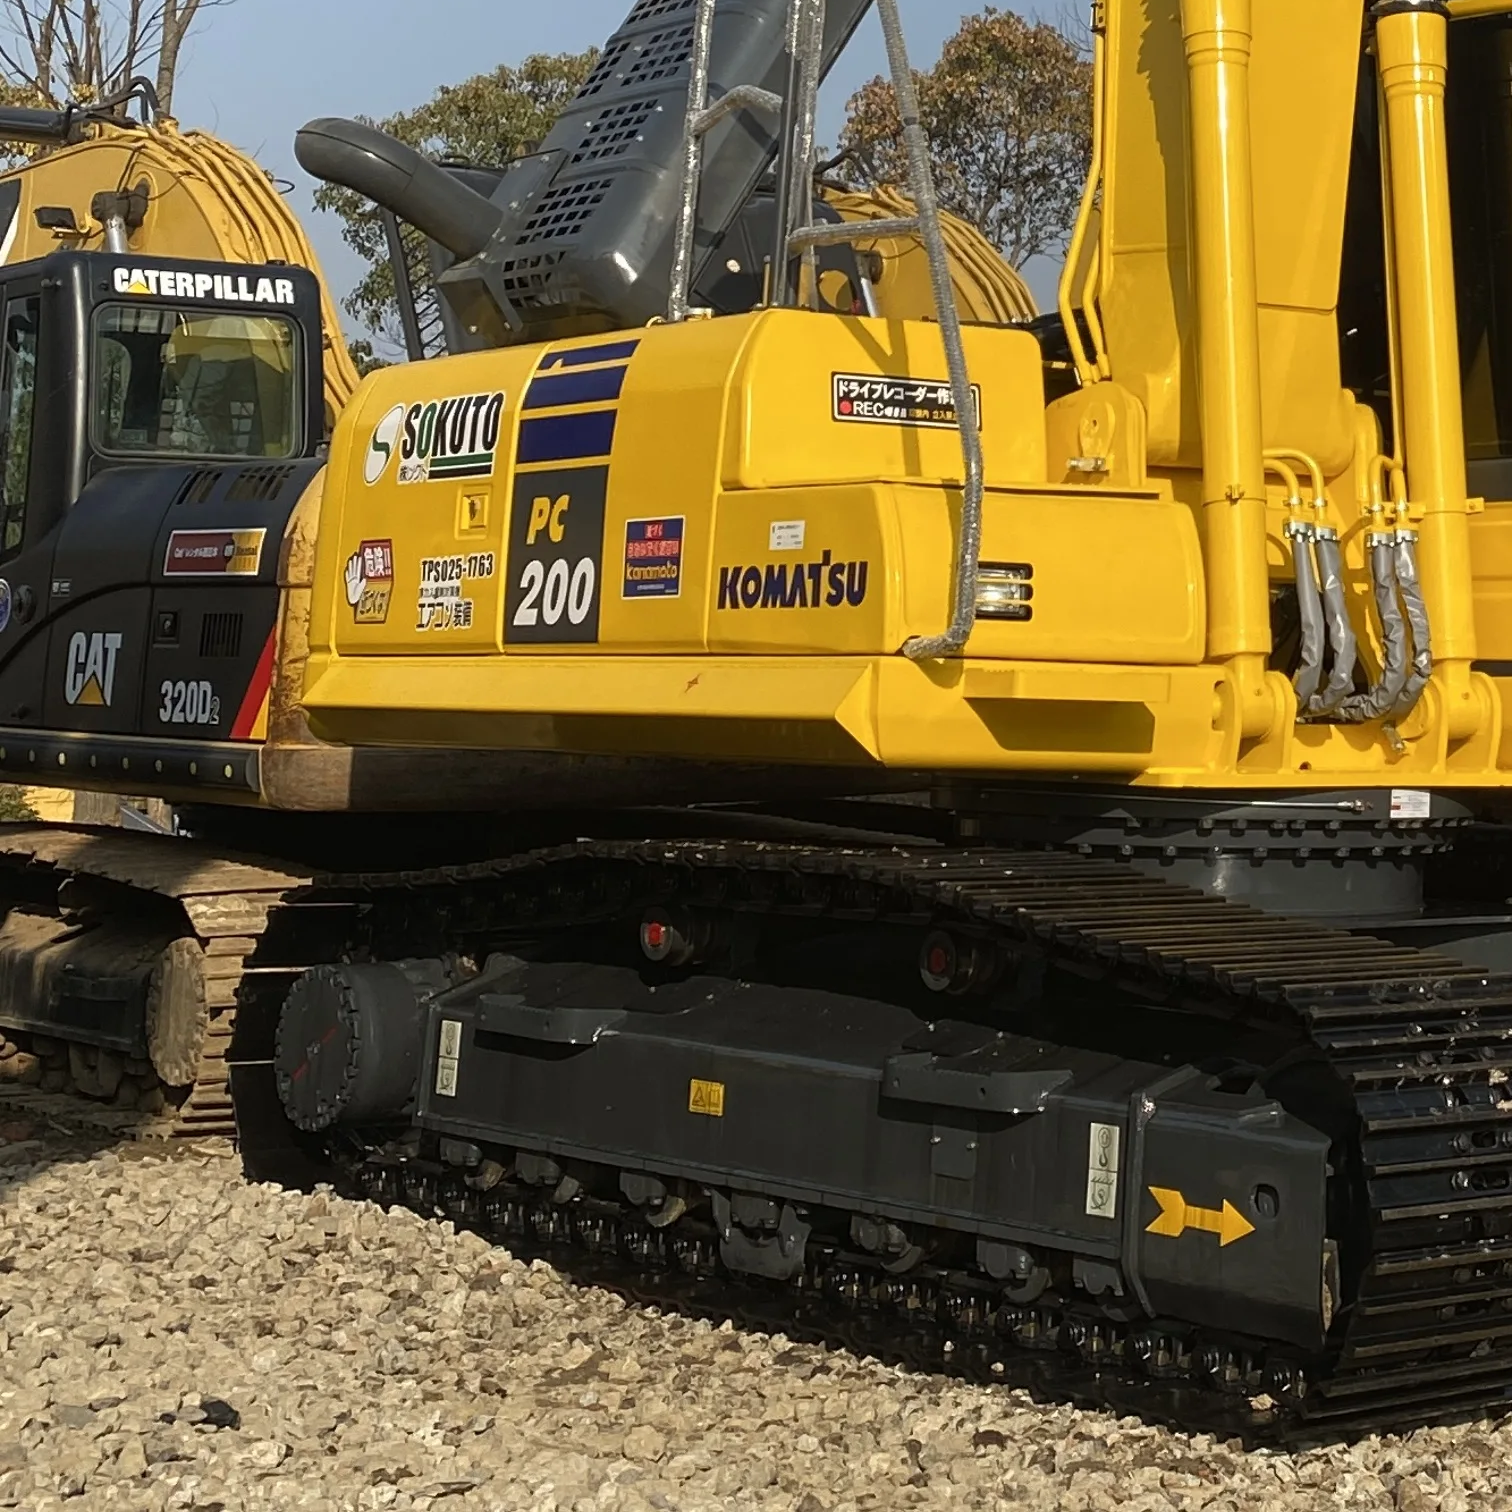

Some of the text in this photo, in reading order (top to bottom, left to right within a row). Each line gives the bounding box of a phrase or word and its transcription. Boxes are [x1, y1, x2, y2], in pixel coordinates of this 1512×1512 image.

[113, 267, 295, 305] CATERPILLAR
[839, 379, 960, 406] ドライブレコーダー作
[853, 401, 884, 417] REC
[401, 392, 505, 460] SOKUTO
[526, 494, 570, 545] PC
[420, 554, 494, 583] TPS025-1763
[513, 557, 596, 626] 200
[717, 549, 869, 610] KOMATSU
[65, 631, 123, 707] CAT
